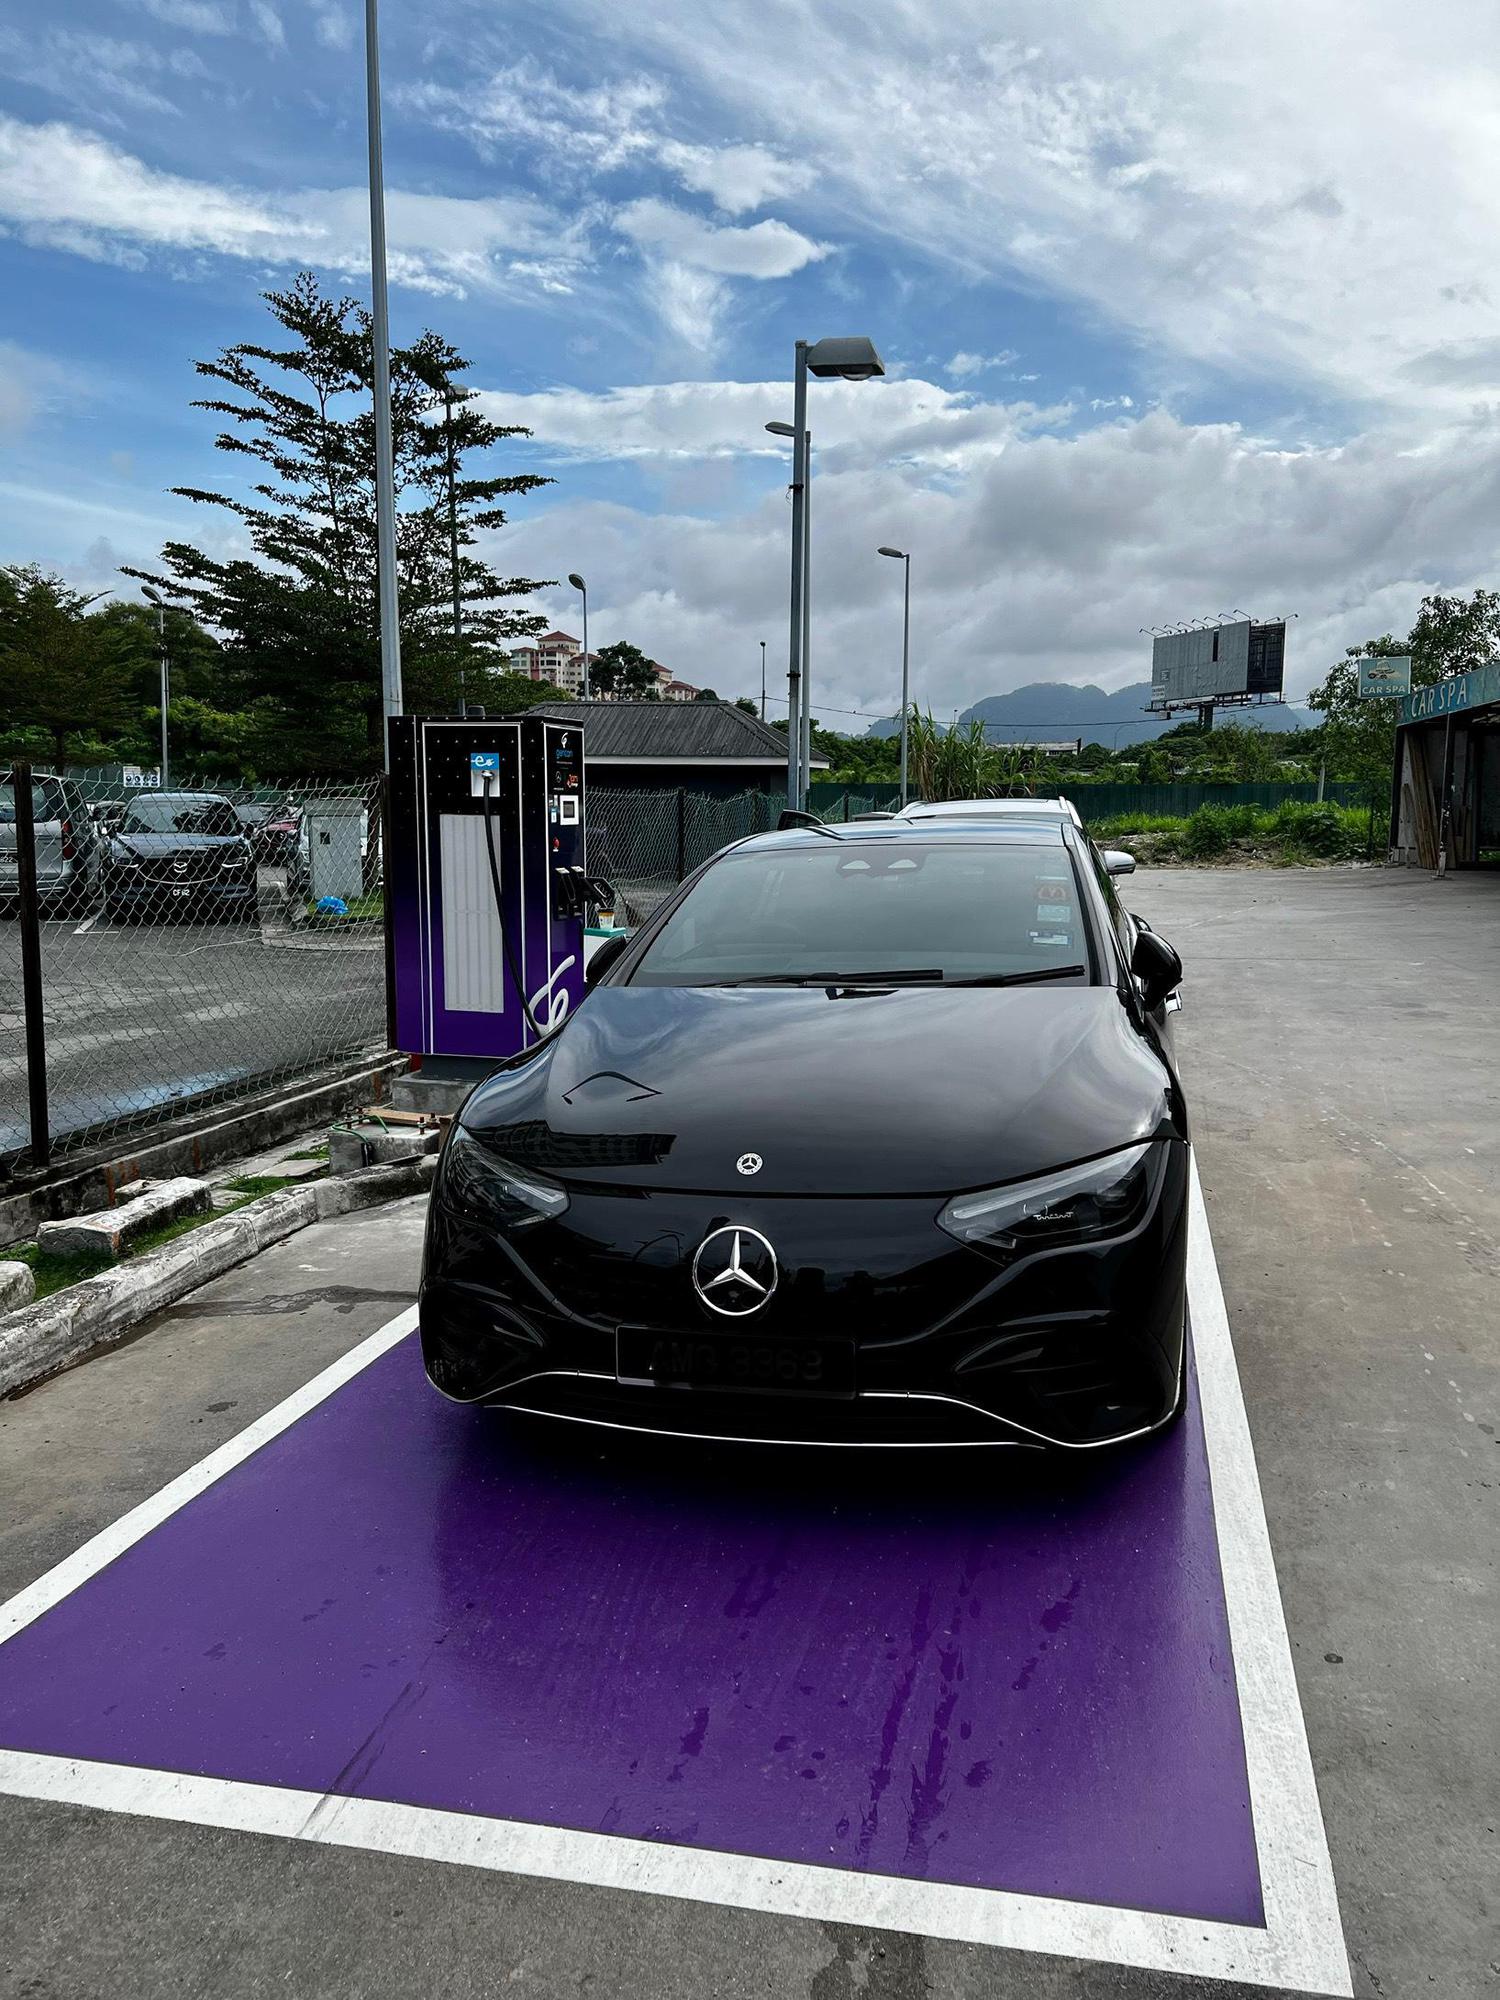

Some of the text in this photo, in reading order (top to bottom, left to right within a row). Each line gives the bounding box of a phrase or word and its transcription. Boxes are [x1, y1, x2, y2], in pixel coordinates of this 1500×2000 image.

[1362, 685, 1406, 695] CAR SPA
[1411, 678, 1467, 718] CAR SPA
